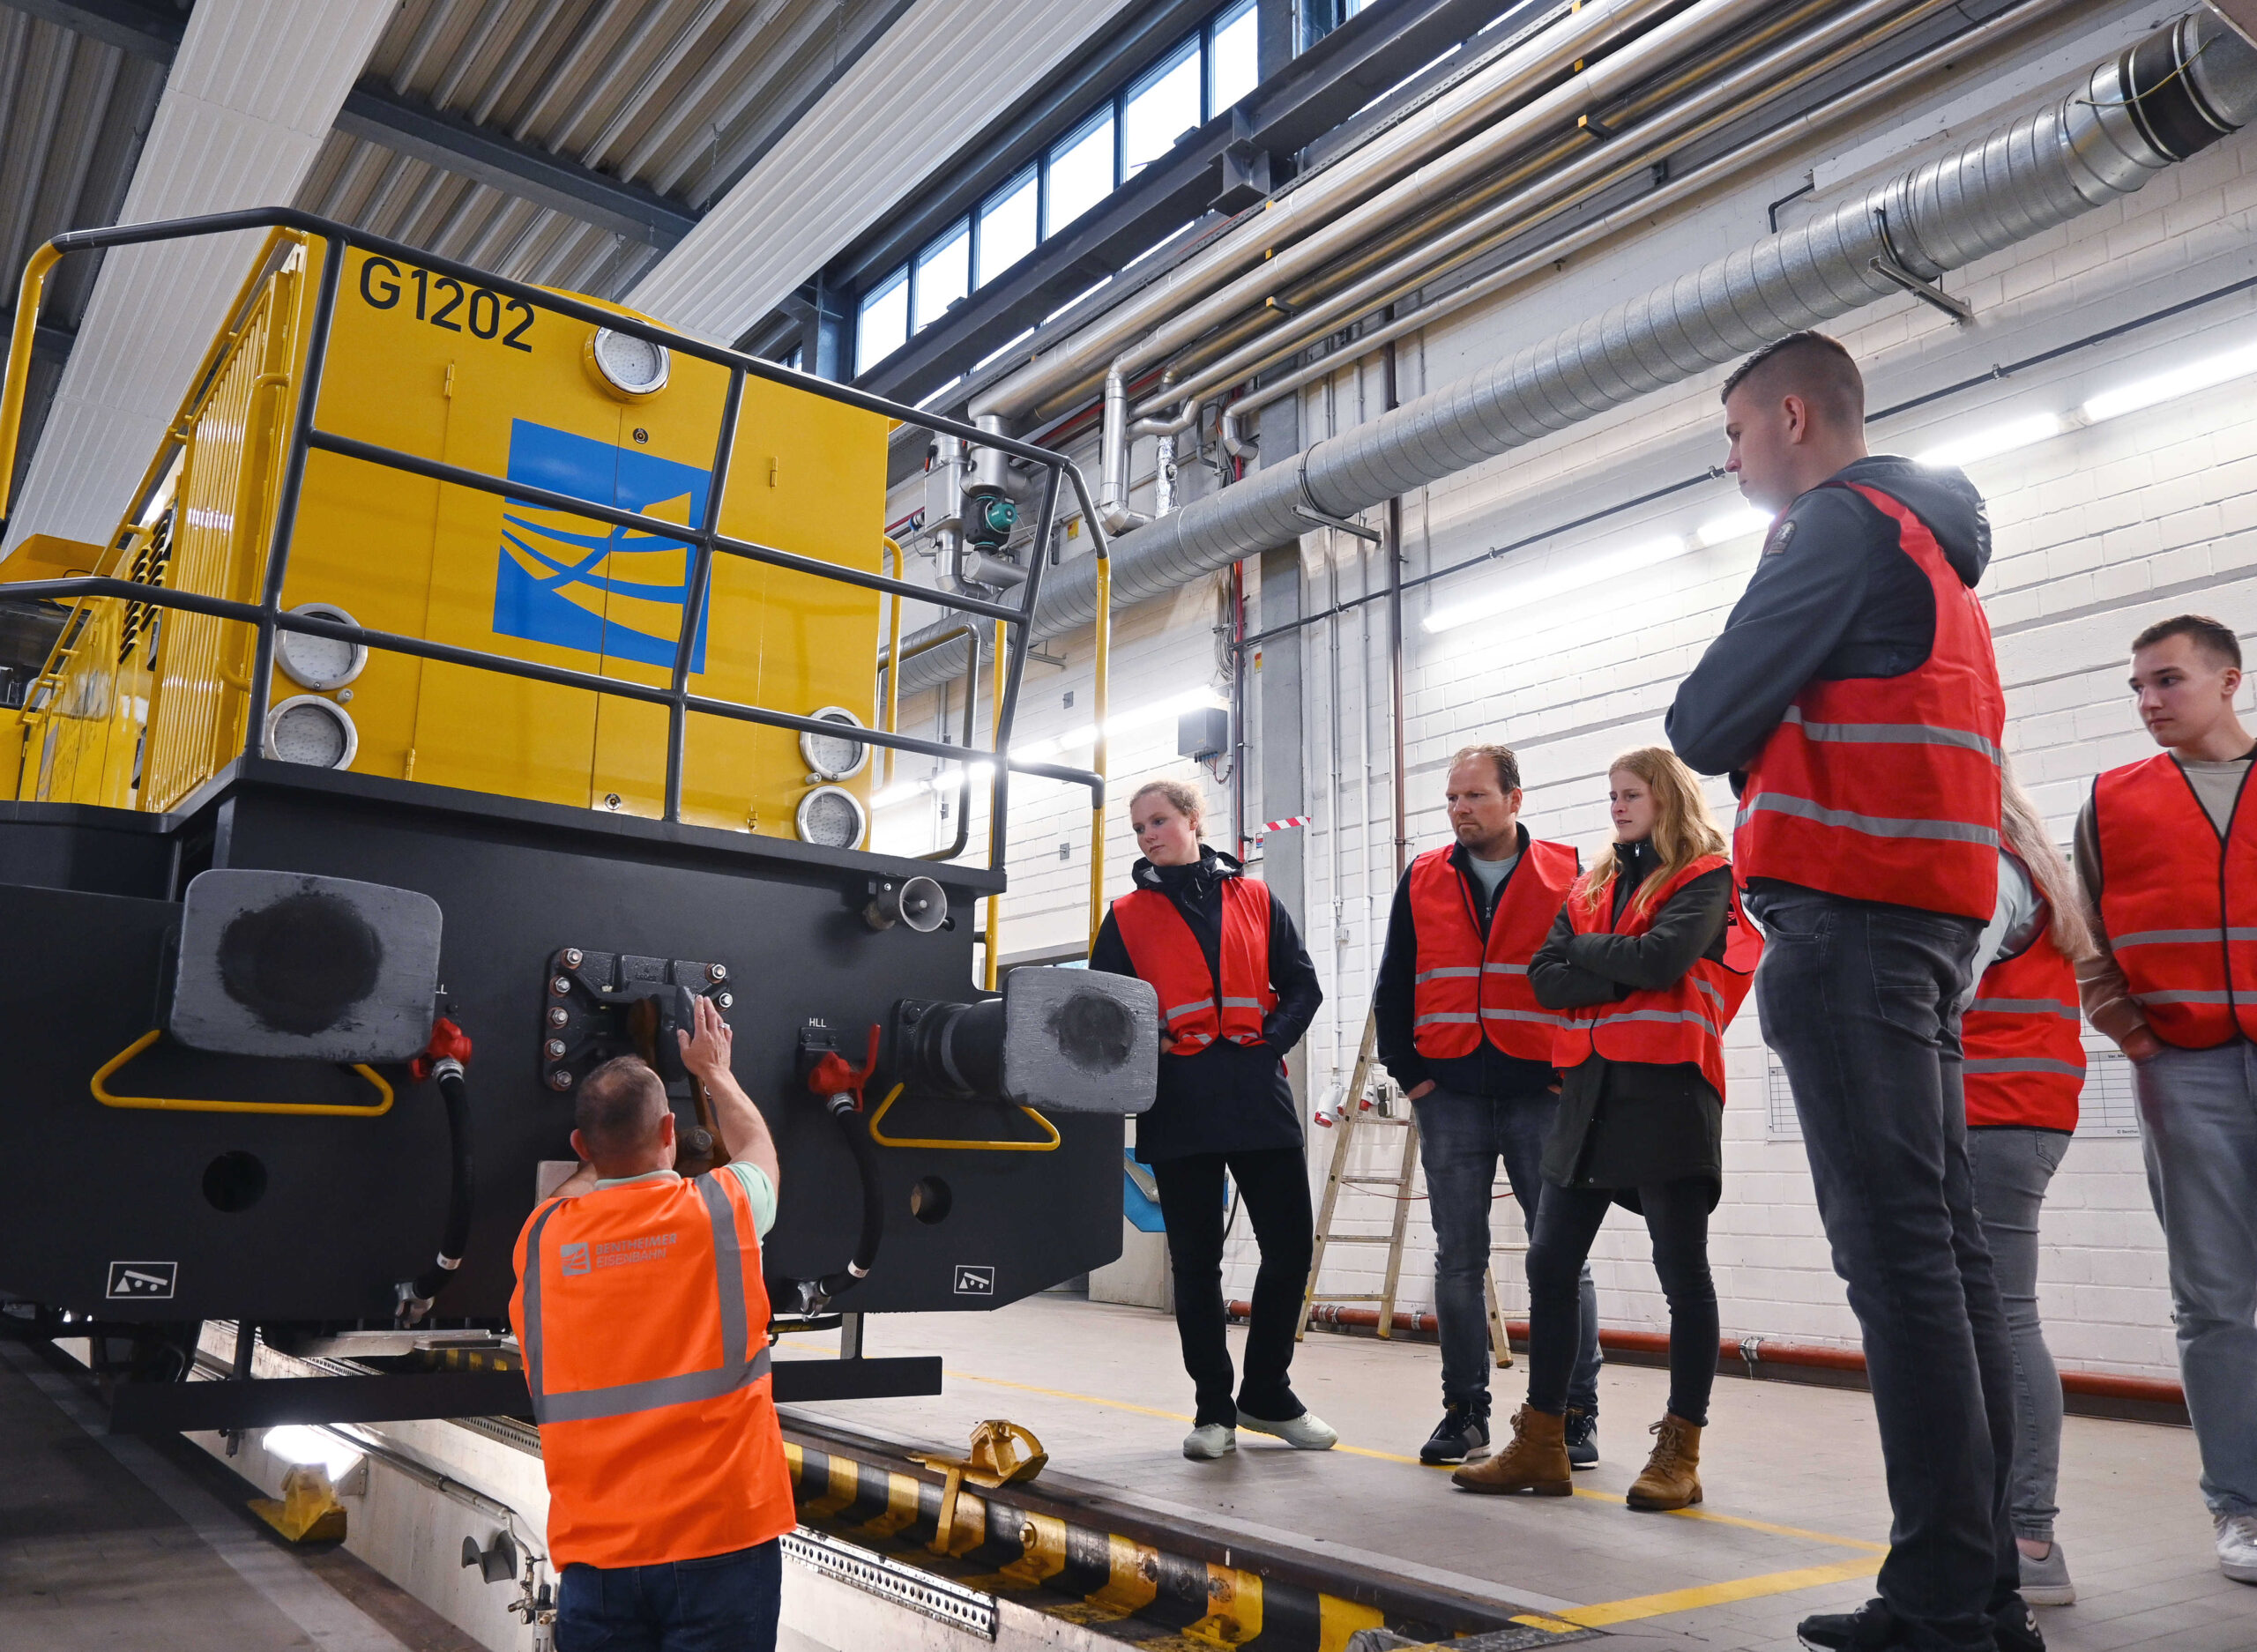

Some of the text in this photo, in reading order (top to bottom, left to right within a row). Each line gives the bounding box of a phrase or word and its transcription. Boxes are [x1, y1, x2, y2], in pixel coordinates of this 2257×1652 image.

[360, 257, 534, 353] G1202
[808, 1017, 827, 1028] HLL
[595, 1233, 677, 1255] BENTHEIMER
[596, 1248, 667, 1269] EISENBAHN
